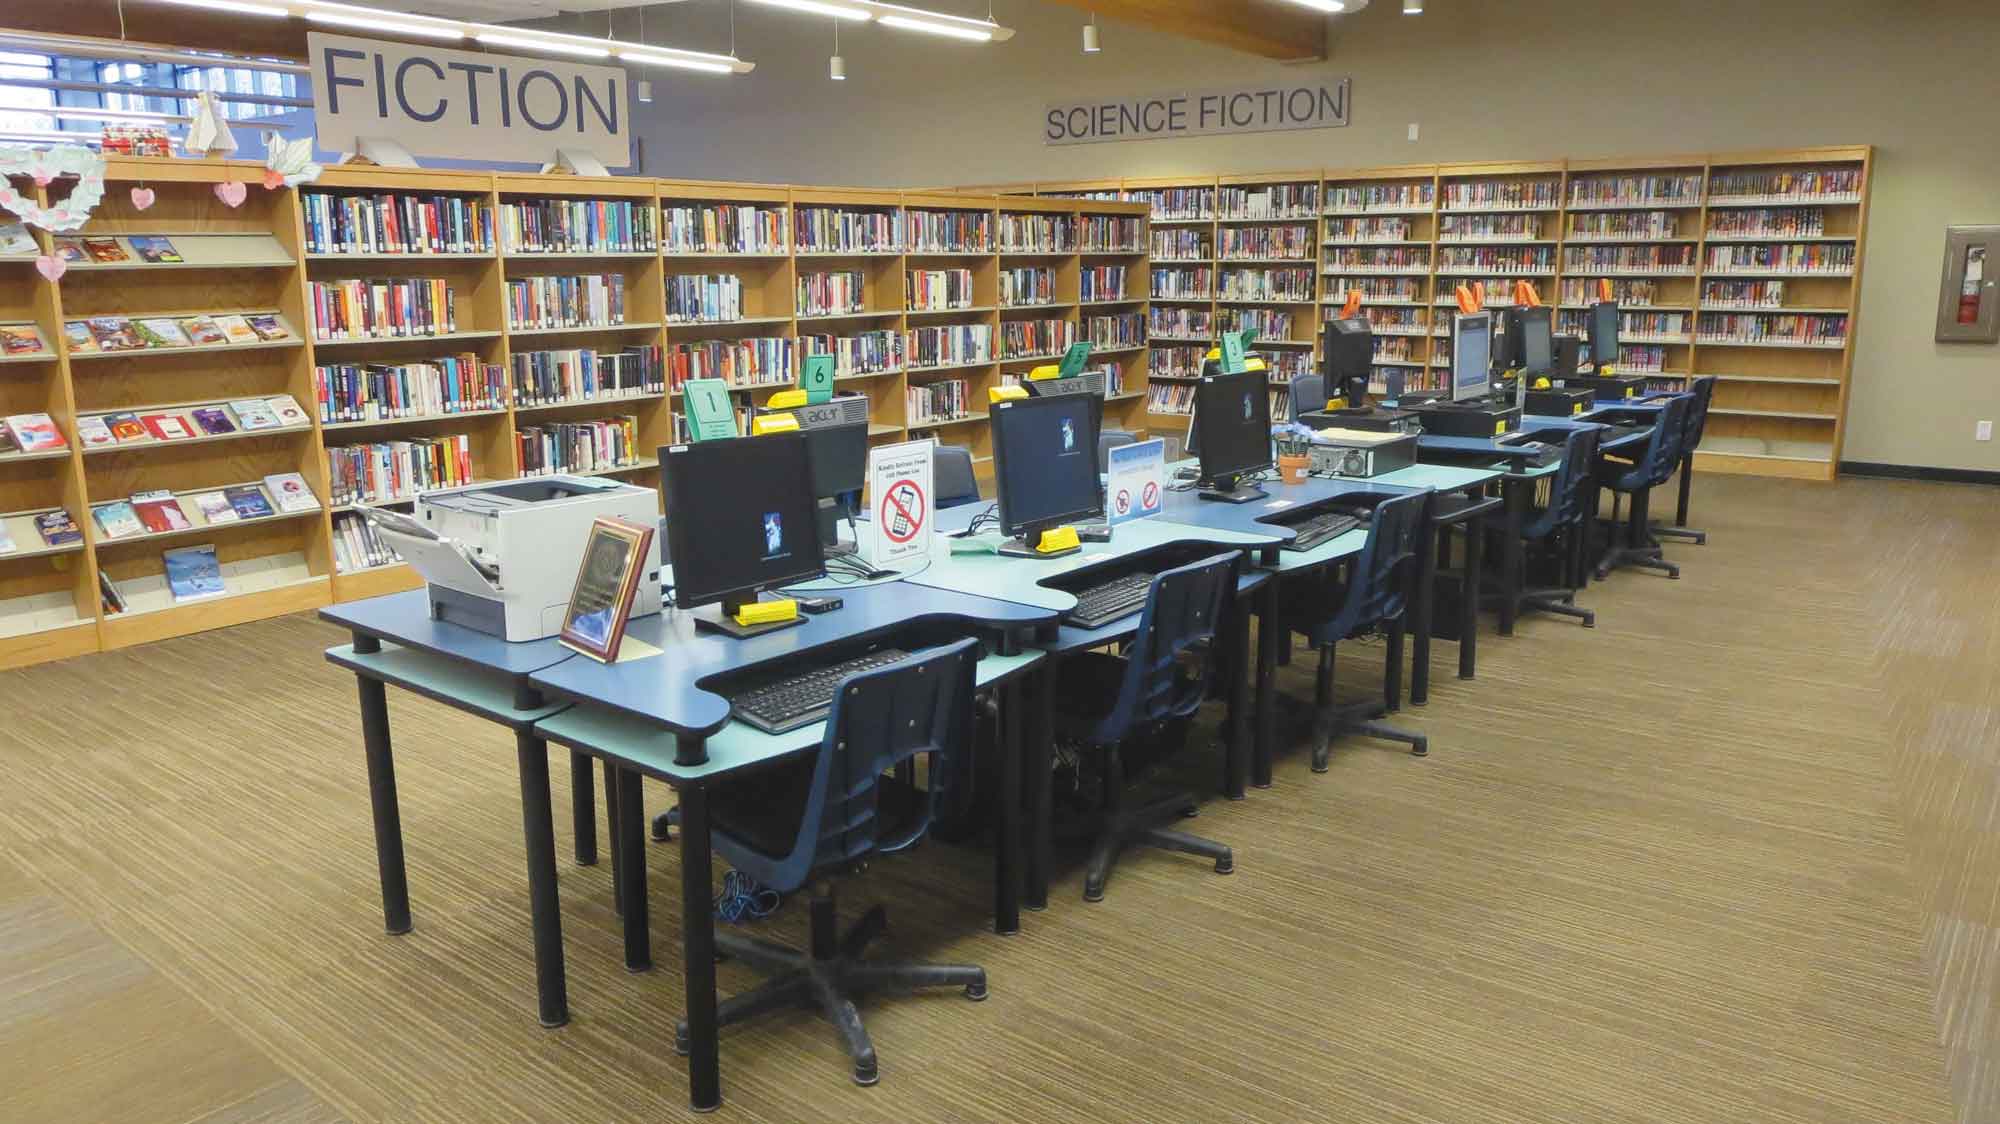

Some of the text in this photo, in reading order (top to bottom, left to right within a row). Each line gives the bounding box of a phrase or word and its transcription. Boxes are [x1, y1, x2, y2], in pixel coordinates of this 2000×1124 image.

[323, 47, 618, 135] FICTION
[1047, 86, 1343, 140] SCIENCE FICTION
[815, 365, 825, 383] 6
[706, 391, 717, 413] 1
[807, 408, 839, 423] acer
